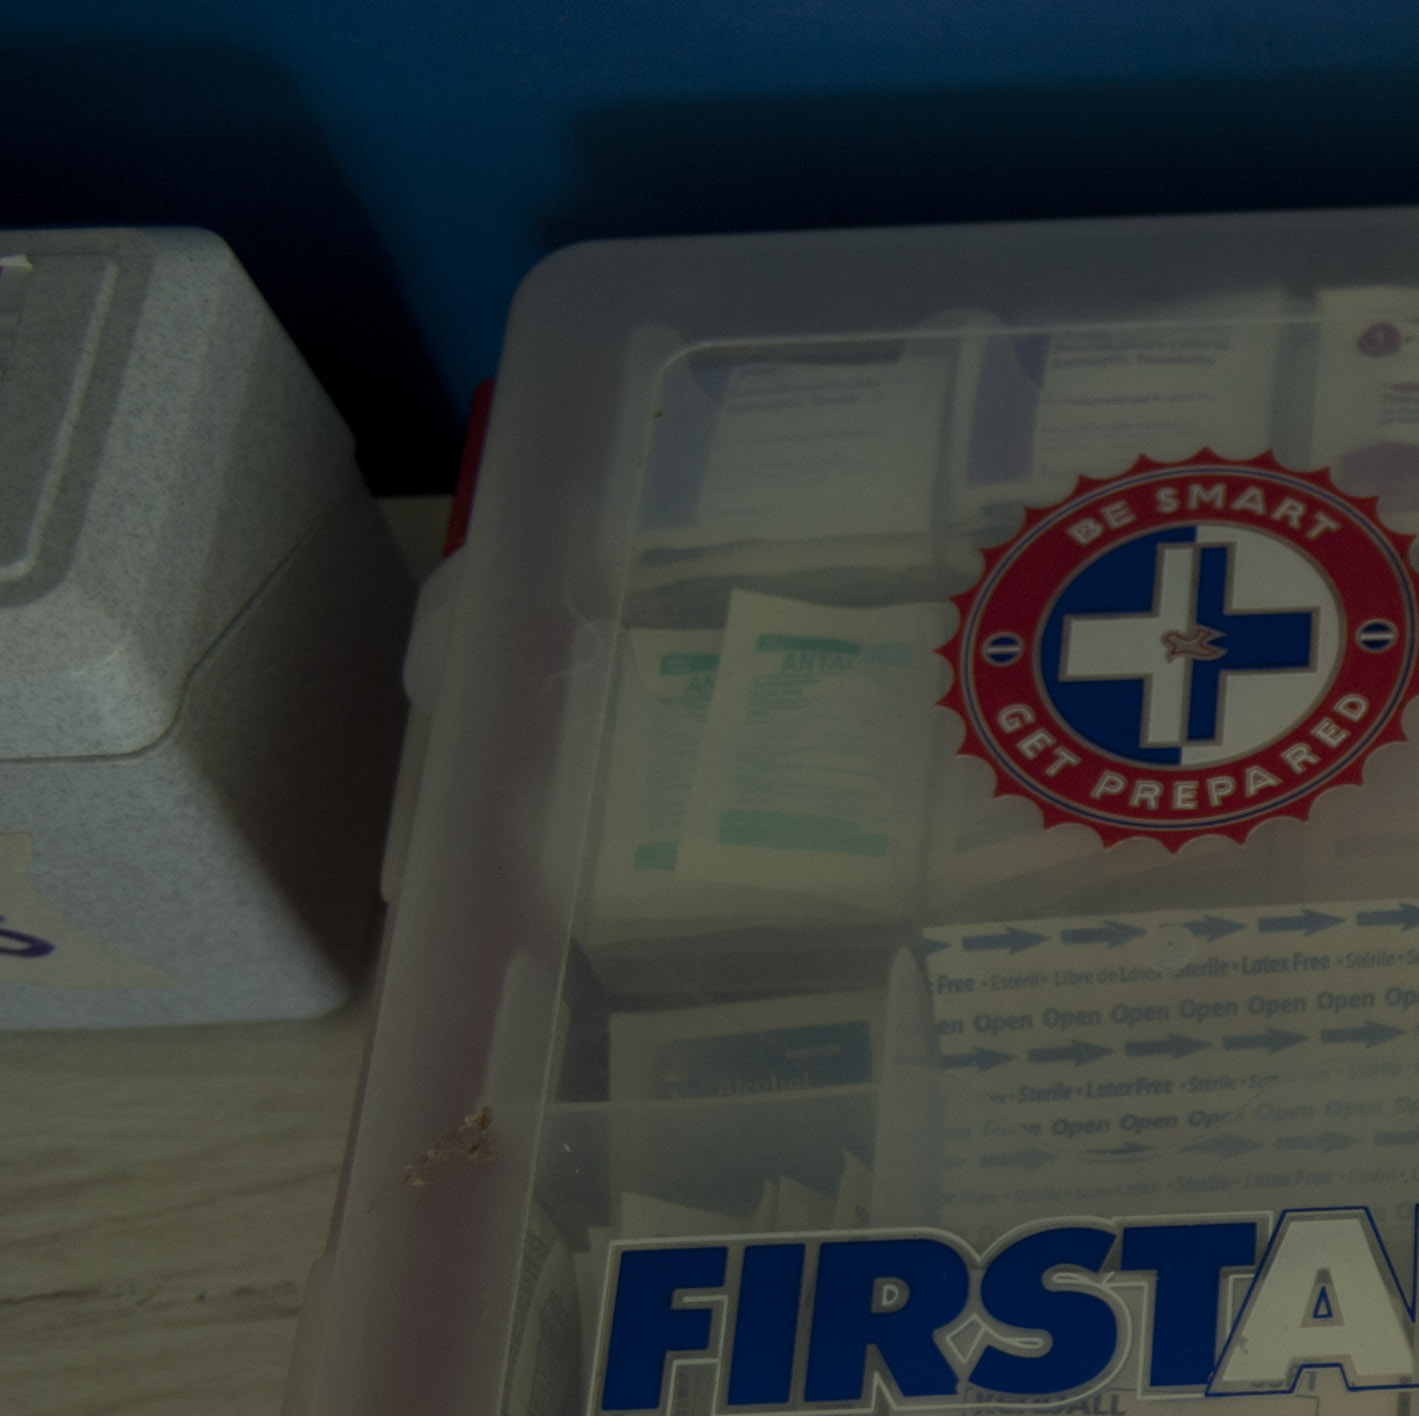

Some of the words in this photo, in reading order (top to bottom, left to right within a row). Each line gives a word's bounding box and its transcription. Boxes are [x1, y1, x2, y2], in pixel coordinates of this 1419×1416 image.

[1066, 497, 1139, 546] BE
[1154, 482, 1343, 542] SMART
[996, 703, 1083, 777] GET
[1089, 694, 1371, 811] PREPARED
[936, 975, 976, 994] Free
[1242, 954, 1290, 975] Latex
[1292, 952, 1330, 971] Free
[974, 1011, 1034, 1037] Open
[1043, 1006, 1102, 1031] Open
[1111, 1002, 1170, 1027] Open
[1179, 998, 1239, 1023] Open
[1247, 994, 1308, 1018] Open
[1315, 989, 1375, 1014] Open
[1134, 1077, 1174, 1096] Free
[1051, 1115, 1111, 1140] Open
[1119, 1110, 1179, 1137] Open
